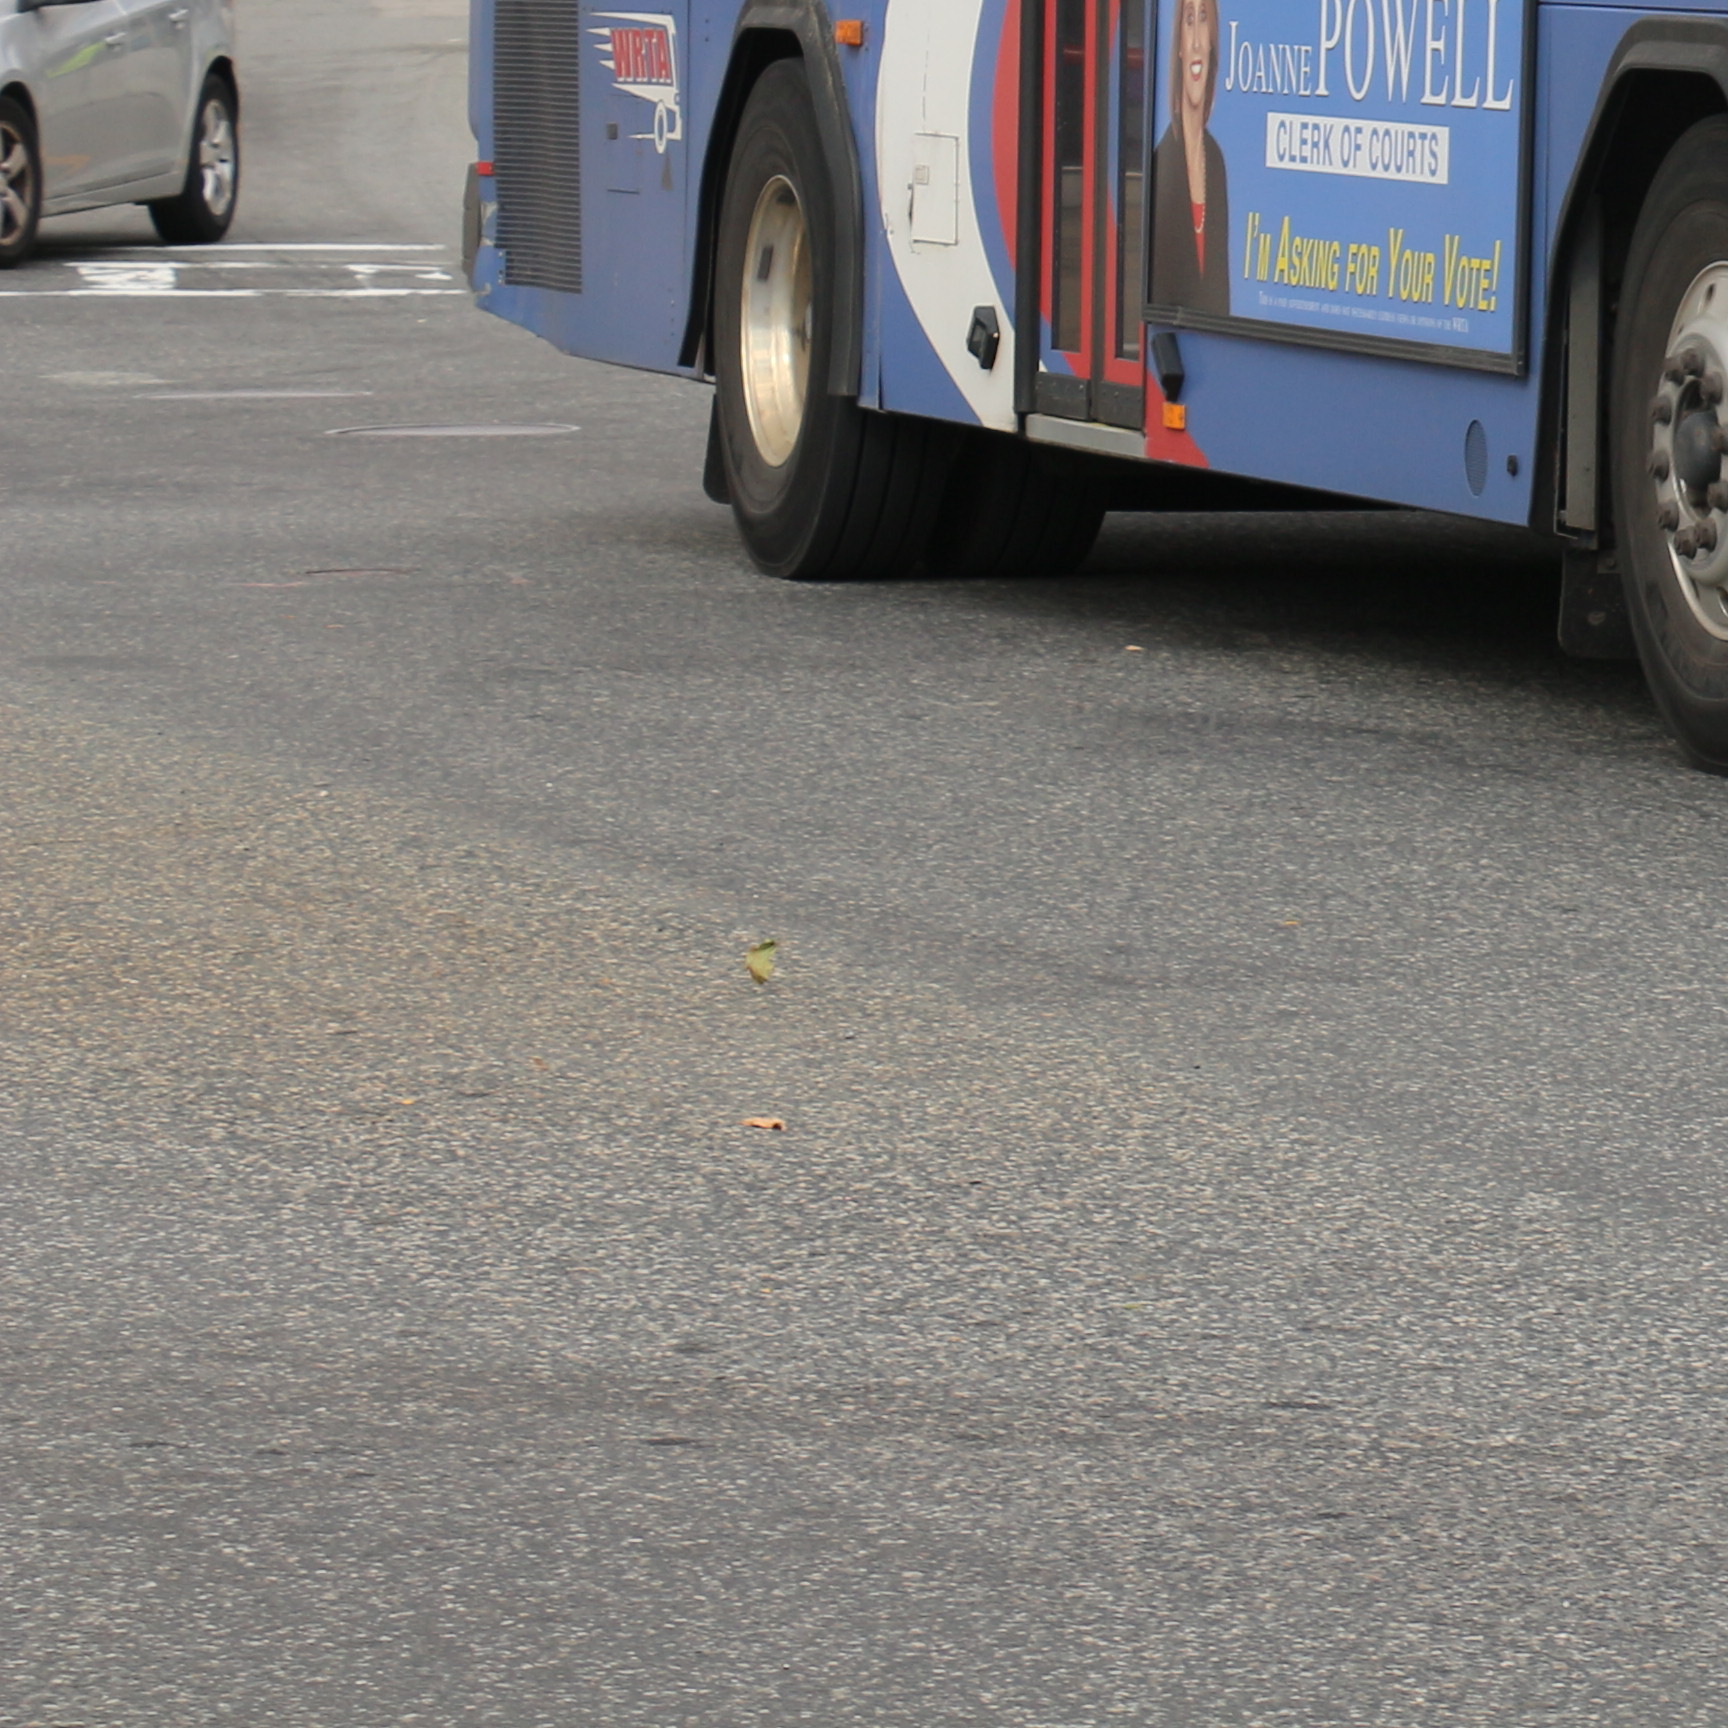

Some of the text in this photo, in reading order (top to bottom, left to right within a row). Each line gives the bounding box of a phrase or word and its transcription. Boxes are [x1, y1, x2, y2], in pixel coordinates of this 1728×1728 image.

[611, 26, 672, 83] WRTA
[1275, 119, 1440, 178] CLERK OF COURTS
